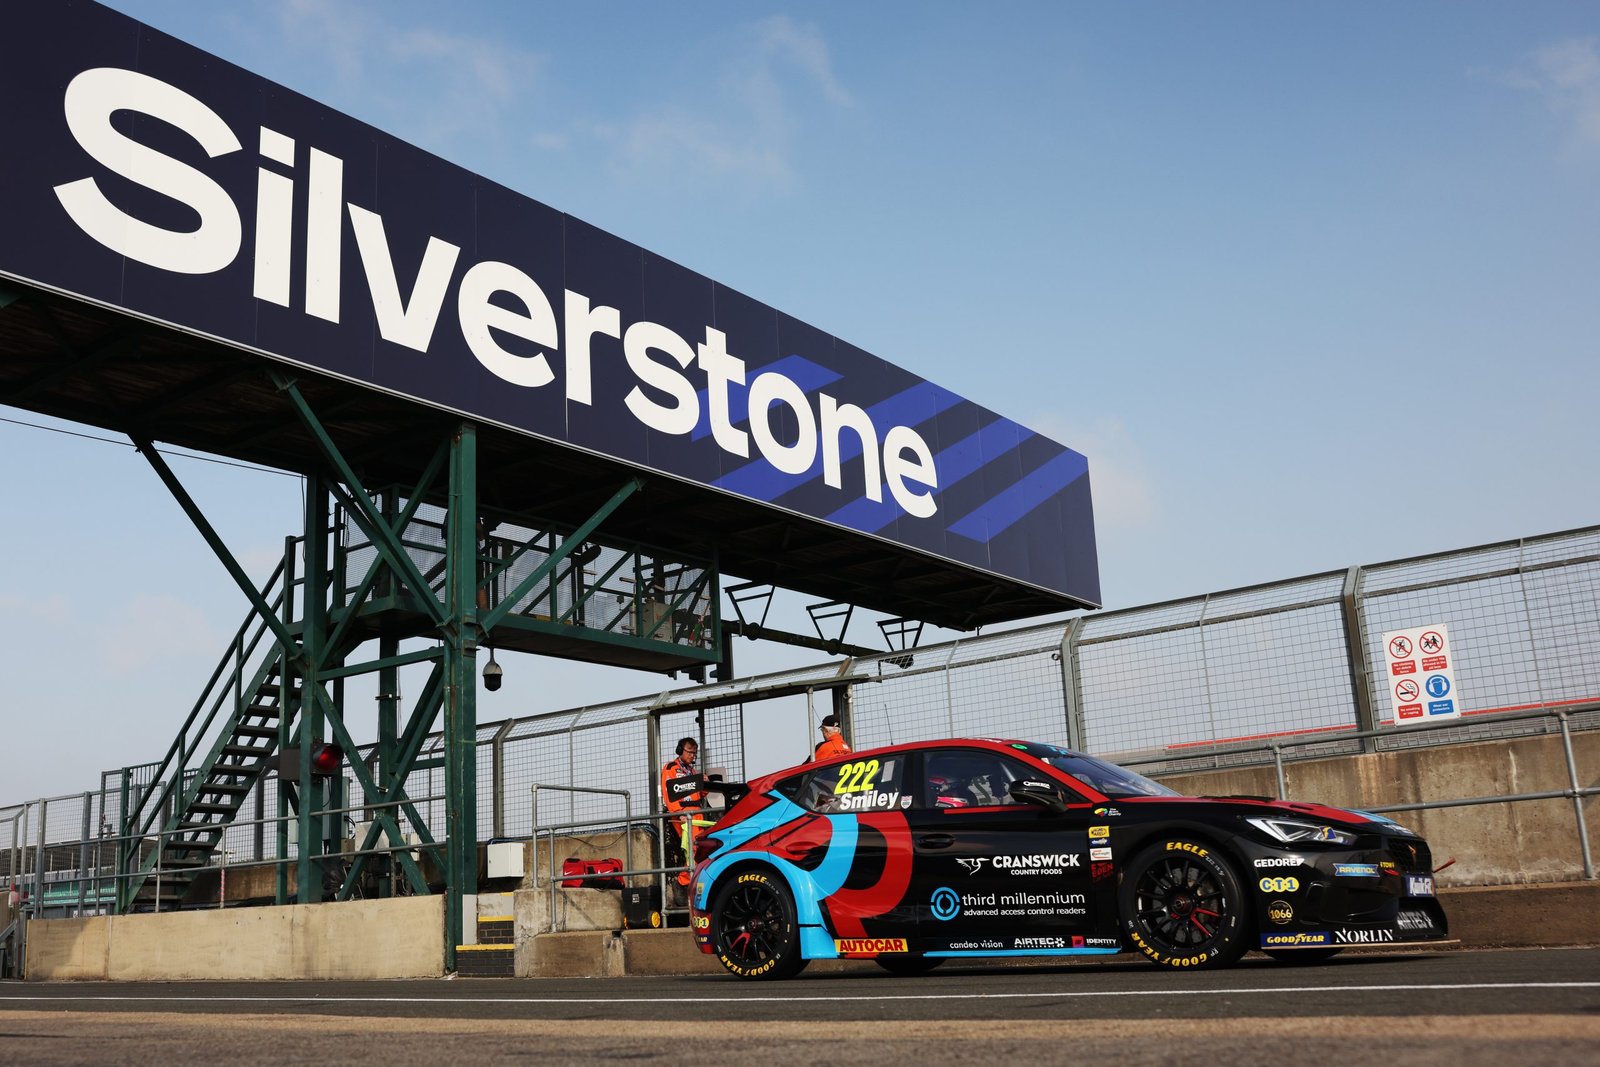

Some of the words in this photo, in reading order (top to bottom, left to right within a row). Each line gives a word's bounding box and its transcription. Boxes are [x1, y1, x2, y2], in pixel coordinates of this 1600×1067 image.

[53, 67, 938, 518] Silverstone
[834, 760, 879, 795] 222
[840, 790, 899, 810] Smiley
[1166, 842, 1209, 858] EAGLE
[992, 854, 1080, 868] CRANSWICK
[738, 874, 767, 884] EAGLE
[962, 893, 996, 906] third
[1001, 892, 1085, 905] millennium
[1027, 907, 1054, 915] control
[1056, 907, 1086, 915] readers
[1270, 909, 1293, 919] 1066
[1014, 937, 1055, 945] AIRTEC
[1267, 934, 1325, 945] GOODYEAR
[1335, 927, 1394, 943] NORLIN
[840, 939, 904, 952] AUTOCAR
[949, 941, 978, 949] candeo
[980, 940, 1003, 948] vision
[1131, 932, 1207, 967] GOODYEAR
[721, 955, 775, 976] GOODYEAR
